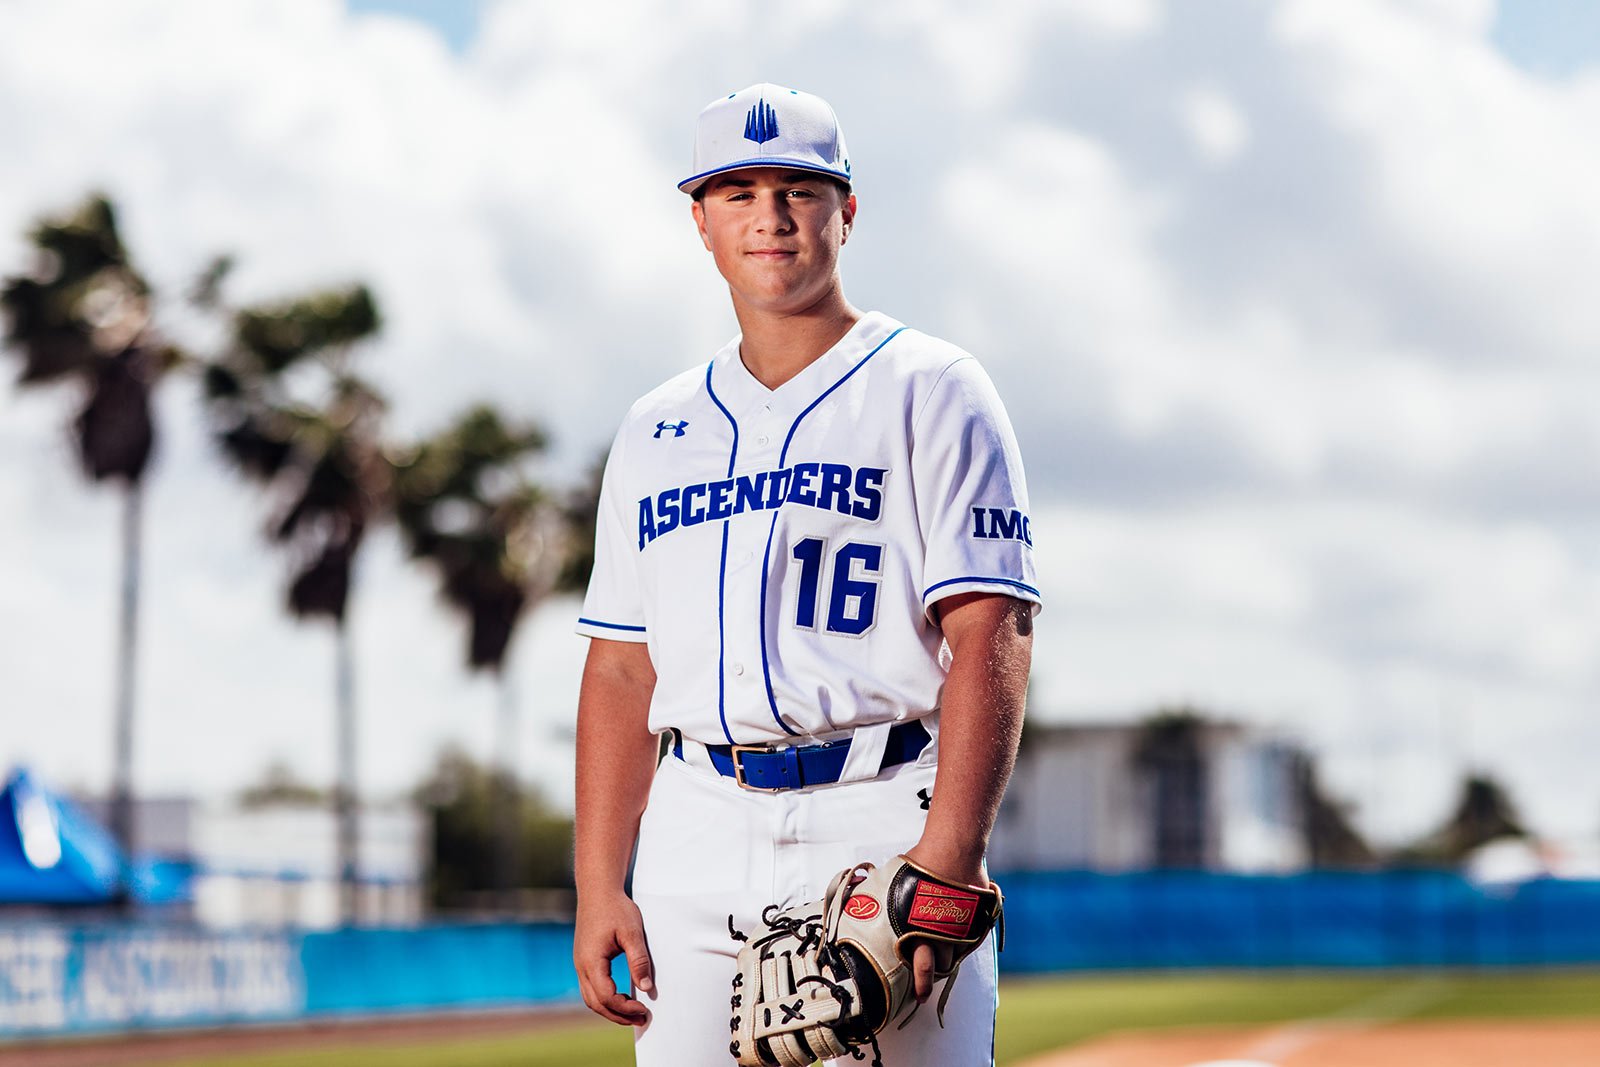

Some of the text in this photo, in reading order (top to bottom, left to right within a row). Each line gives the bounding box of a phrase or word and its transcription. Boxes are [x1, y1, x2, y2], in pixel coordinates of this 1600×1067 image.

[637, 462, 890, 551] ASCENDERS
[792, 538, 883, 635] 16
[919, 901, 971, 922] Rawlings
